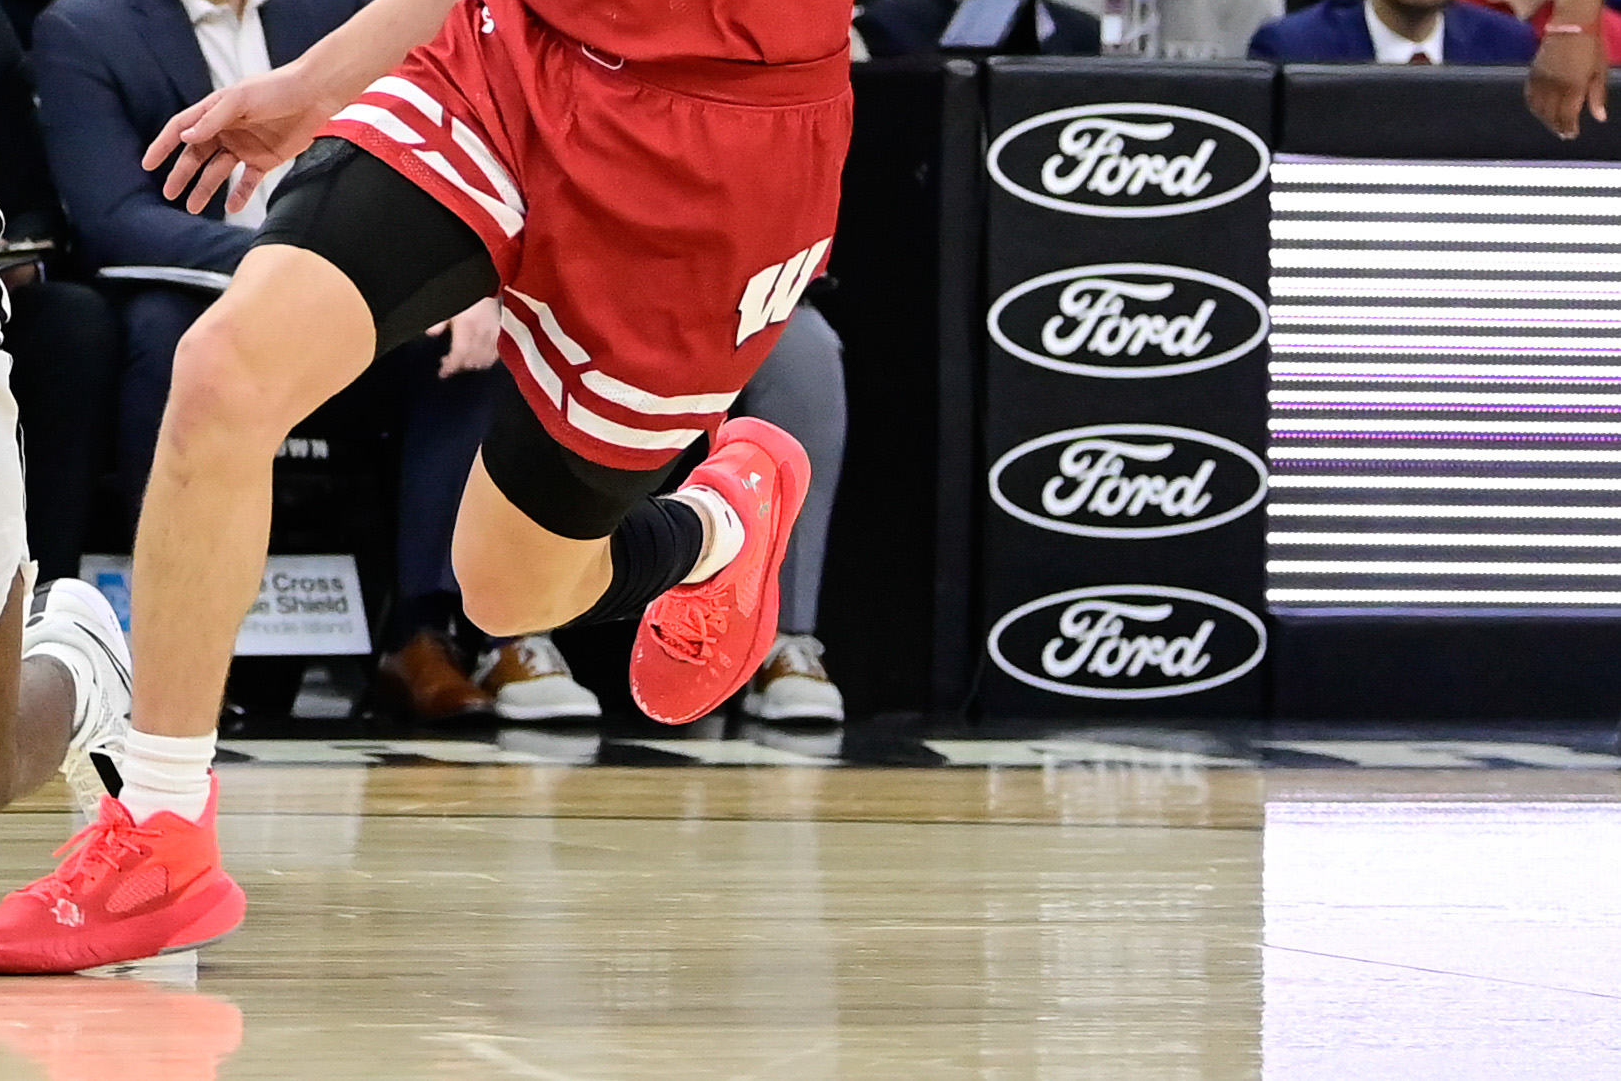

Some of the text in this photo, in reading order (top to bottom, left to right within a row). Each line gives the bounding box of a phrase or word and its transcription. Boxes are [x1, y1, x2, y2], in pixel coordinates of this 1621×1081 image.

[1041, 119, 1217, 197] Ford
[735, 236, 833, 349] W
[1041, 279, 1217, 357] Ford
[1041, 439, 1216, 517] Ford
[271, 572, 343, 592] Cross
[276, 596, 349, 614] Shield
[1041, 600, 1216, 677] Ford
